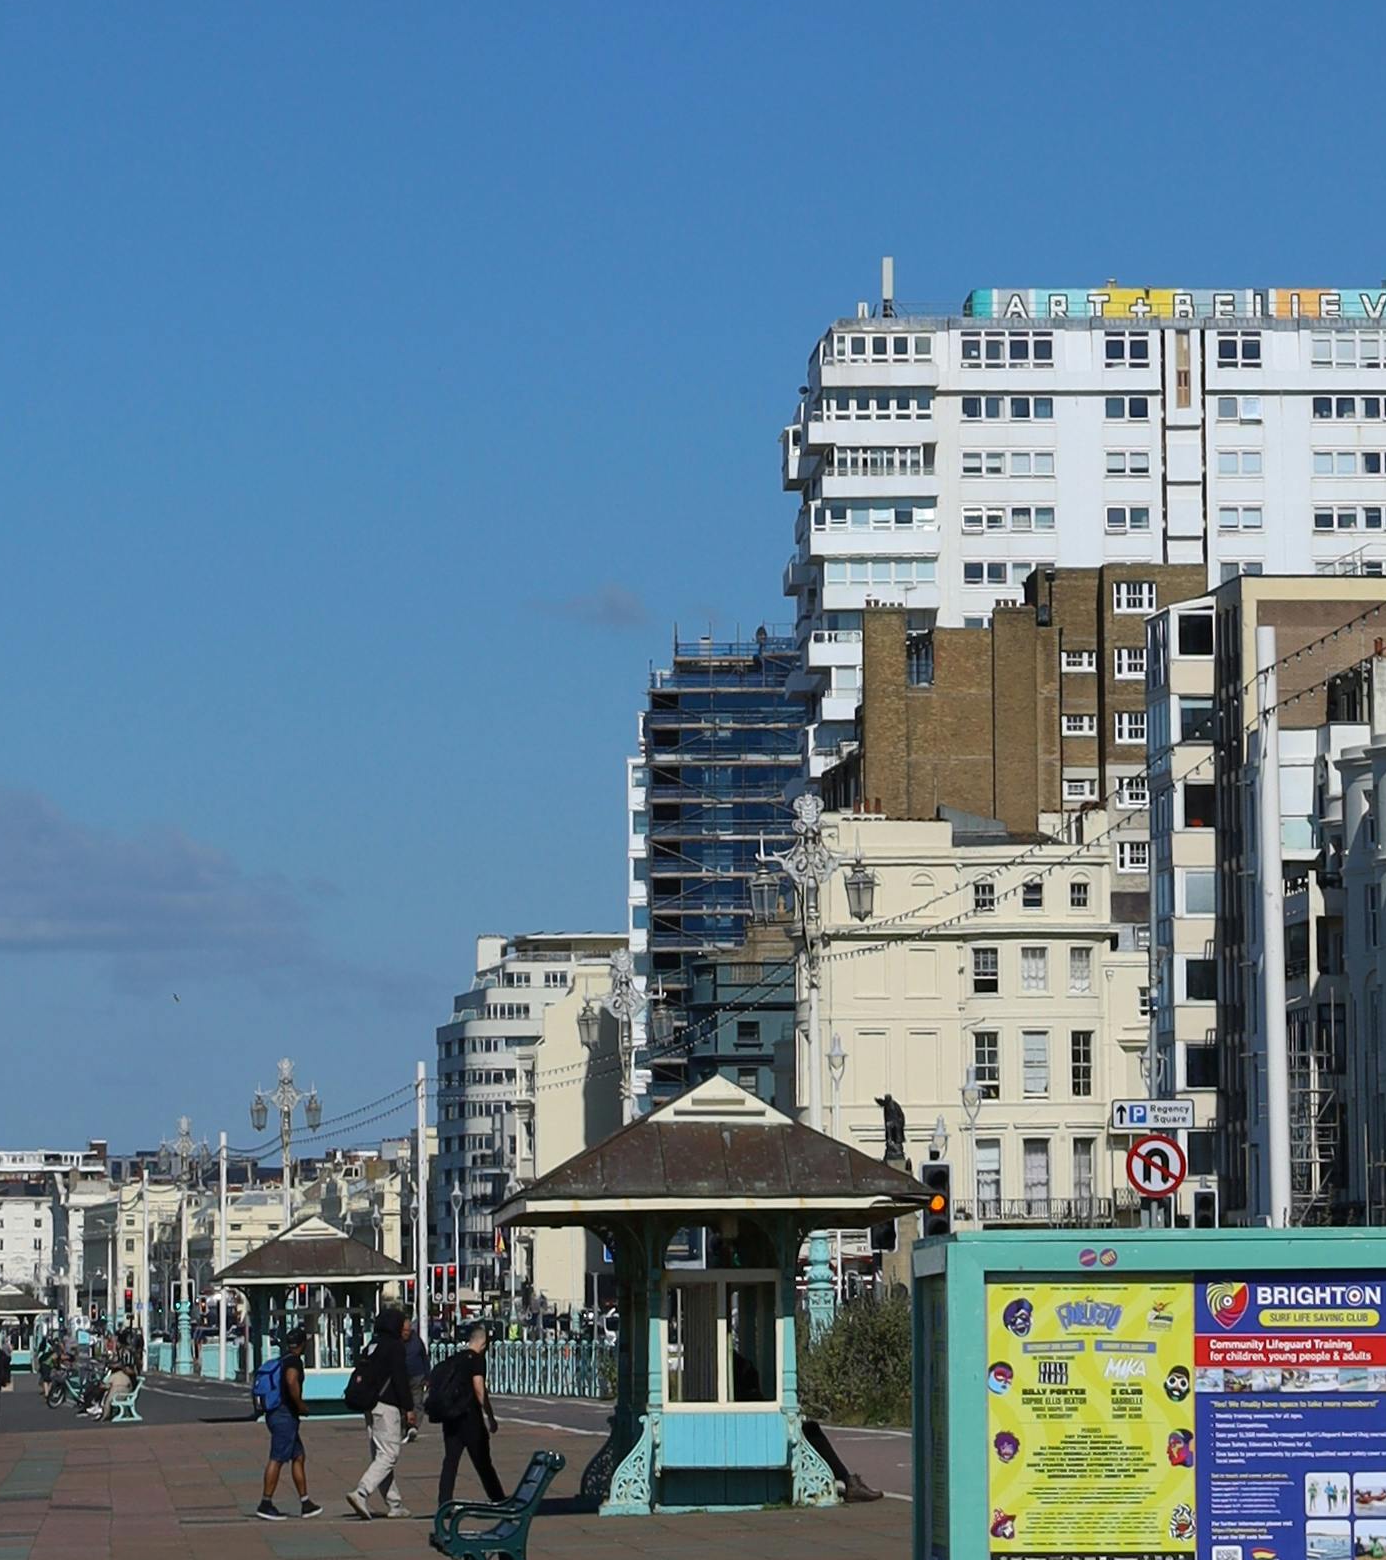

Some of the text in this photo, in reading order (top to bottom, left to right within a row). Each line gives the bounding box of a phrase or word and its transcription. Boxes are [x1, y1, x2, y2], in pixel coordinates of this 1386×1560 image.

[1003, 292, 1111, 319] ART
[1150, 1105, 1190, 1114] Regency
[1153, 1115, 1187, 1124] Square
[1256, 1285, 1382, 1306] BRIGHTON
[1269, 1312, 1368, 1323] SURF LIFE SAVING CLUB
[1209, 1339, 1353, 1351] Community Lifeguard Training
[1209, 1351, 1372, 1362] for children, young people & adults
[1104, 1358, 1147, 1380] MIKA
